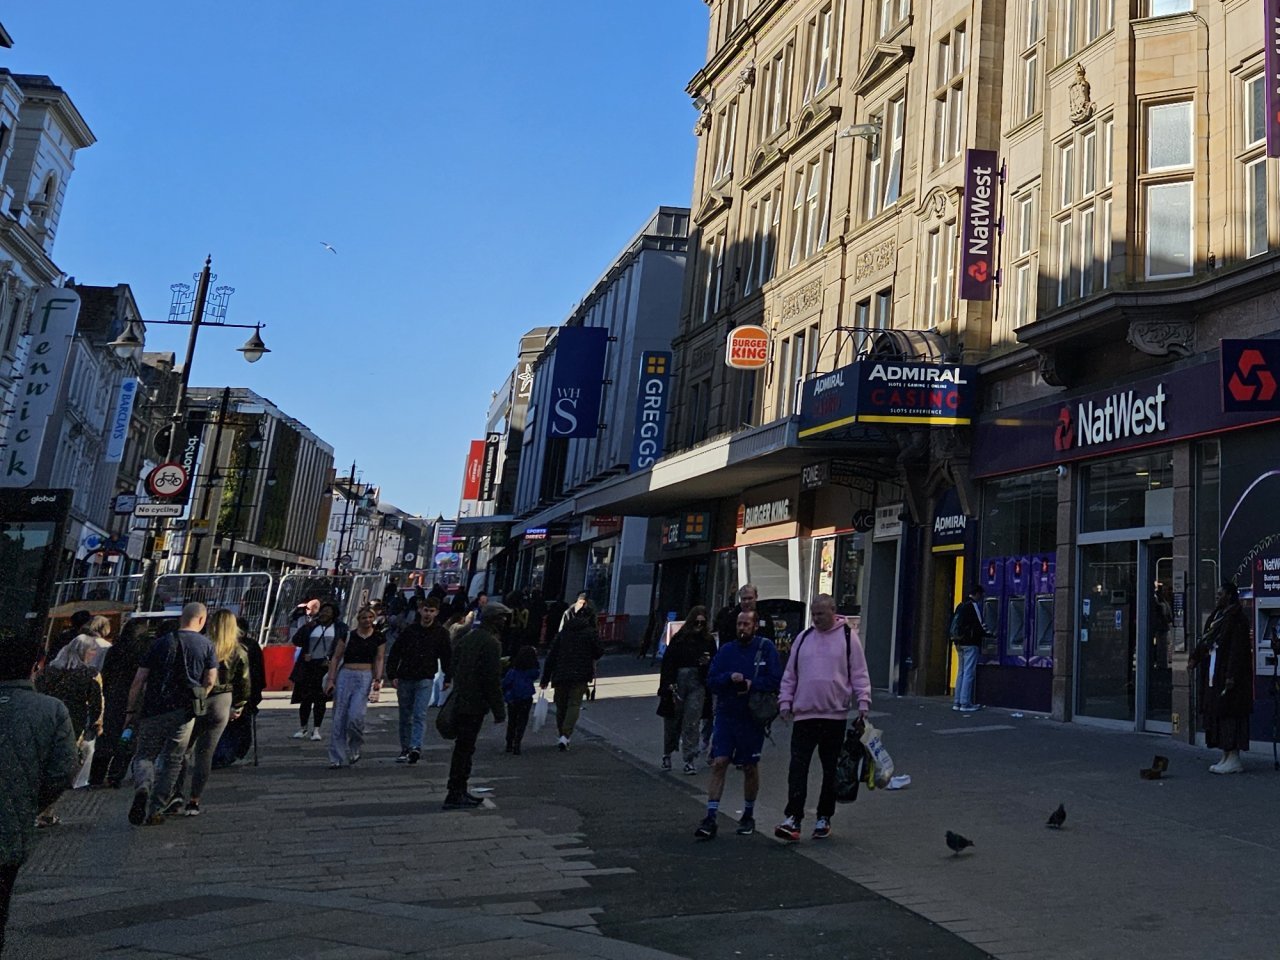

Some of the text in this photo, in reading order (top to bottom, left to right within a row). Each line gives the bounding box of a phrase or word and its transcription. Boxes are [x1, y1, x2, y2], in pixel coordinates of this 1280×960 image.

[969, 166, 992, 255] NatWest
[731, 347, 768, 360] KING
[732, 339, 768, 348] BURGER
[813, 369, 845, 397] ADMIRAL
[868, 364, 968, 385] ADMIRAL
[557, 387, 581, 399] WH
[870, 390, 964, 410] CASINO
[113, 394, 132, 440] BARCLAYS
[551, 398, 578, 435] S
[890, 407, 942, 416] SLOTS EXPERIENCE
[1078, 382, 1166, 448] NatWest
[637, 378, 664, 469] GREGGS
[485, 434, 499, 444] JD
[31, 495, 57, 505] global
[137, 505, 179, 517] No cycling
[745, 502, 771, 529] BURGER
